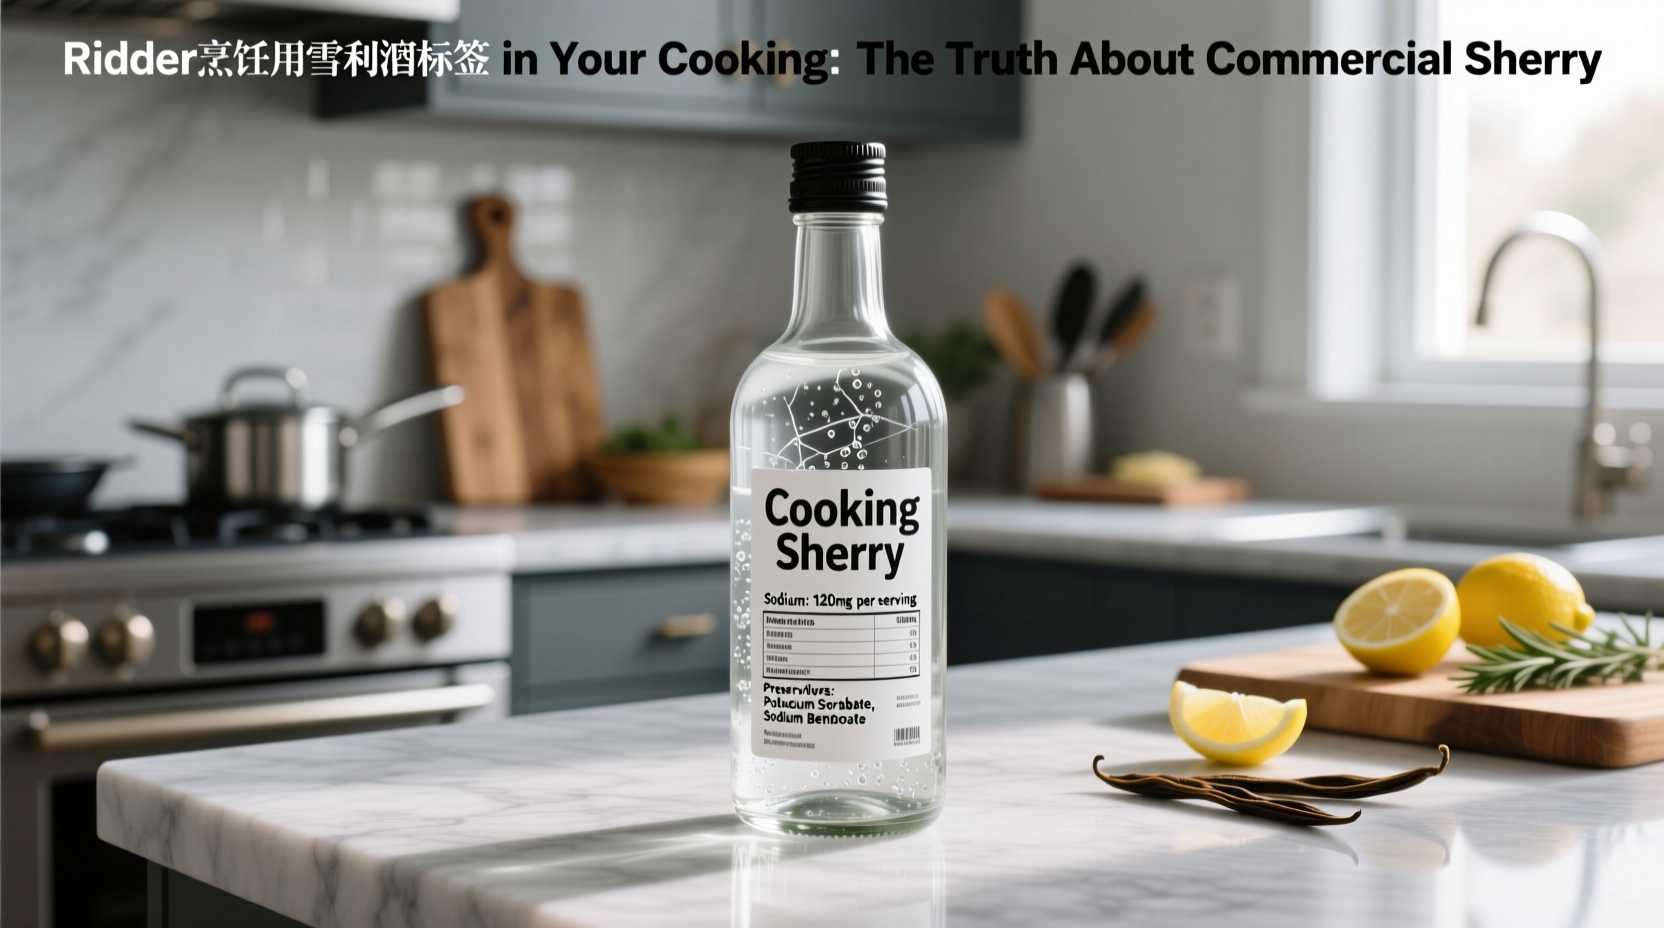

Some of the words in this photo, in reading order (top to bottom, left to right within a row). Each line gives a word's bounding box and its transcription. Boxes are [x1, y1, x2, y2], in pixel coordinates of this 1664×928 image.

[765, 488, 920, 536] Cooking
[776, 532, 905, 580] Sherry
[764, 592, 809, 607] Sodium:
[813, 593, 853, 610] 120mg
[857, 596, 875, 610] per
